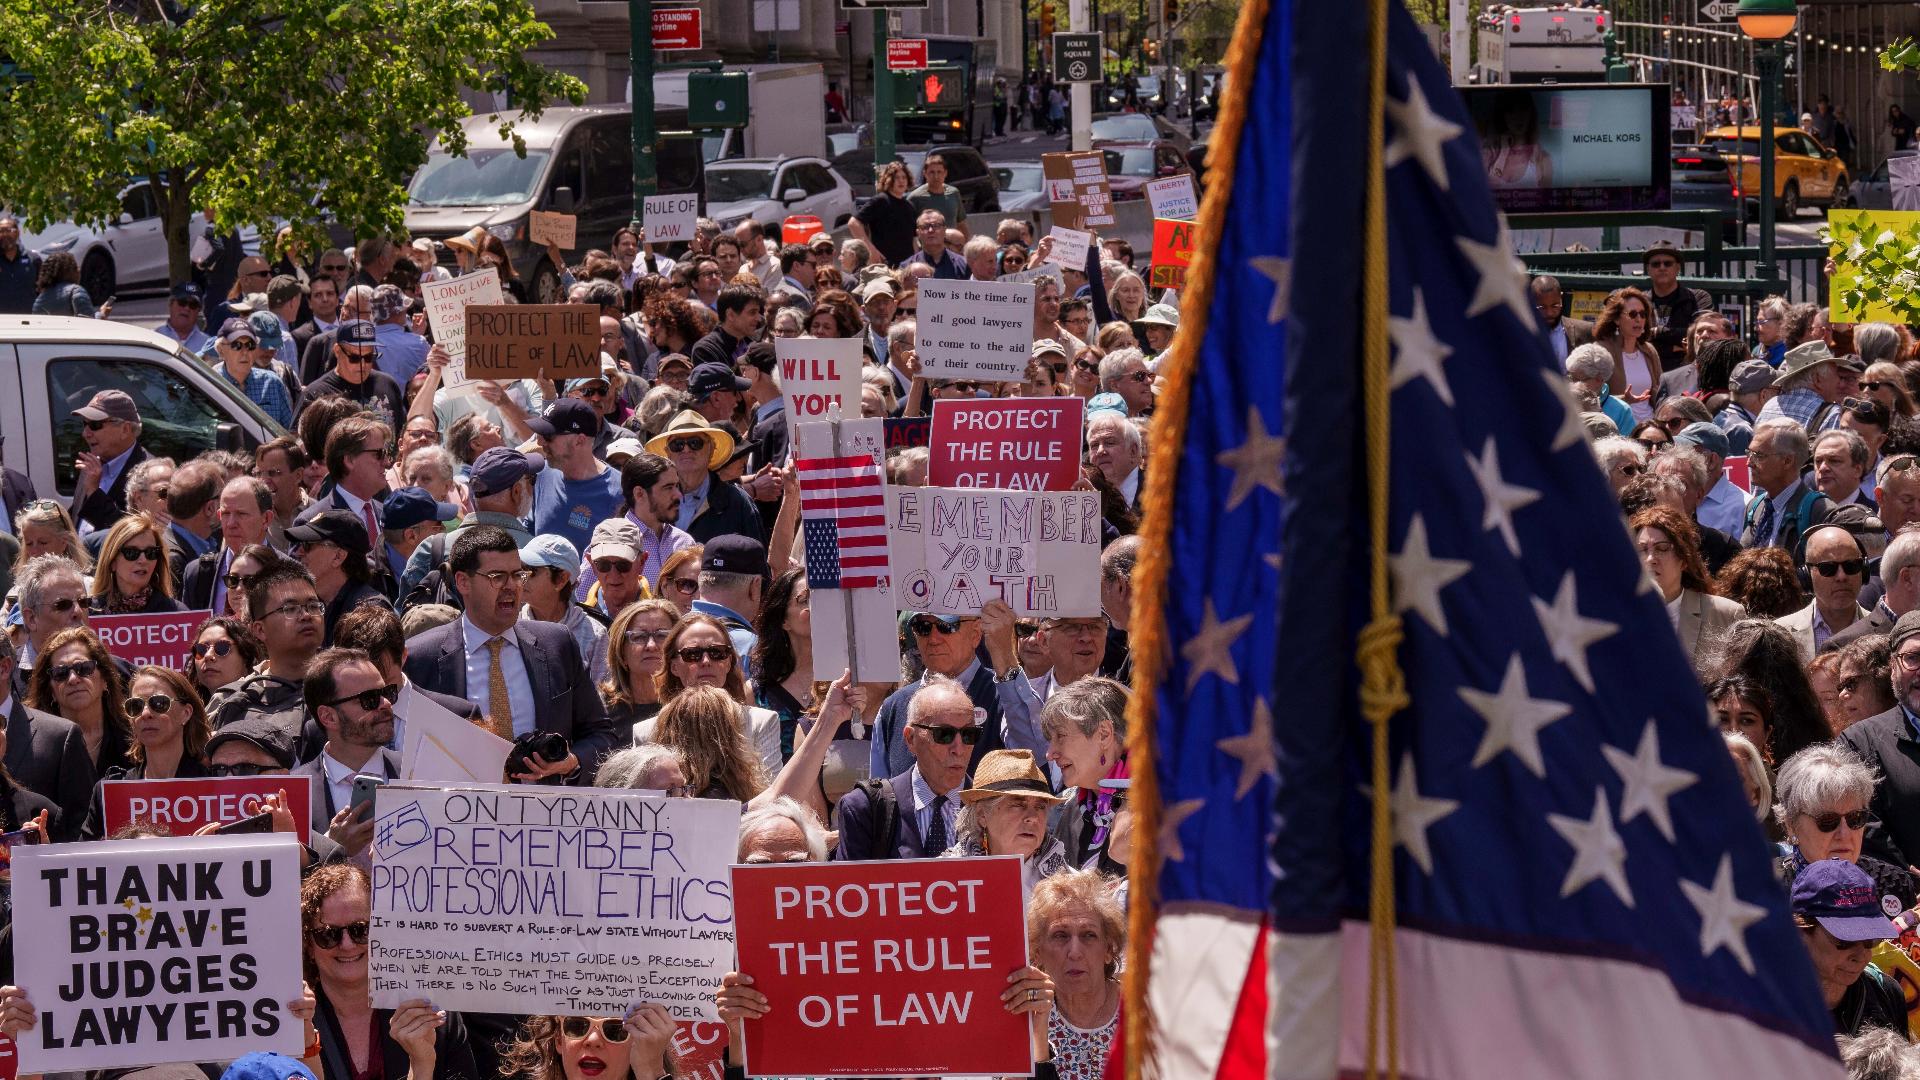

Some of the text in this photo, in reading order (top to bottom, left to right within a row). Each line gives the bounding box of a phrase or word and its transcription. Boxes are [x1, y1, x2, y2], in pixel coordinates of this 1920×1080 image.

[659, 13, 693, 21] STANDING
[1710, 4, 1733, 15] ONE
[652, 23, 678, 32] nytime
[1063, 50, 1091, 59] SQUARE
[1573, 134, 1641, 144] MICHAEL KORS
[1154, 180, 1187, 192] LIBERTY
[645, 199, 696, 214] RULE OF
[1158, 198, 1191, 210] JUSTICE
[1160, 206, 1193, 218] FOR ALL
[654, 224, 681, 238] LAW
[431, 285, 467, 302] LONG
[470, 275, 494, 291] LIVE
[924, 289, 1028, 304] Now is the time for
[434, 302, 454, 313] THE
[469, 312, 552, 337] PROTECT
[561, 311, 593, 336] THE
[930, 314, 1023, 330] all good lawyers
[469, 343, 600, 369] RULE OF LAW
[921, 338, 1025, 353] to come to the aid
[782, 358, 841, 380] WILL
[924, 358, 1021, 373] of their country.
[953, 409, 1062, 430] PROTECT
[947, 441, 1062, 461] THE RULE
[889, 492, 1098, 544] EMEMBER
[939, 542, 1025, 573] YOUR
[902, 569, 1058, 611] OATH
[90, 623, 192, 646] ROTECT
[445, 794, 670, 831] ON TYRANNY:
[376, 807, 428, 849] #5
[434, 827, 686, 873] REMEMBER
[41, 859, 272, 907] THANK U
[372, 865, 732, 924] PROFESSIONAL ETHICS
[774, 879, 983, 920] PROTECT
[69, 907, 248, 953] BRAVE
[410, 920, 439, 931] HARD
[443, 922, 458, 932] TO
[464, 923, 513, 934] SUBVERT
[606, 926, 640, 937] STATE
[531, 950, 570, 963] MUST
[576, 952, 617, 966] GUIDE
[622, 955, 641, 966] US
[648, 955, 715, 968] PRECISELY
[769, 935, 992, 975] THE RULE
[58, 953, 258, 1002] JUDGES
[370, 962, 405, 974] WHEN
[412, 963, 430, 975] WE
[437, 965, 467, 976] ARE
[471, 966, 503, 977] TOLD
[508, 969, 539, 979] THAT
[546, 969, 570, 981] THE
[574, 969, 632, 984] SITUATION
[649, 971, 723, 988] EXCEPTIONA
[372, 976, 408, 991] THEN
[416, 978, 456, 991] THERE
[502, 980, 537, 995] SUCH
[540, 981, 582, 996] THING
[586, 987, 604, 997] AS
[638, 986, 697, 1001] FOLLOWING
[798, 991, 974, 1028] OF LAW
[41, 998, 280, 1050] LAWYERS
